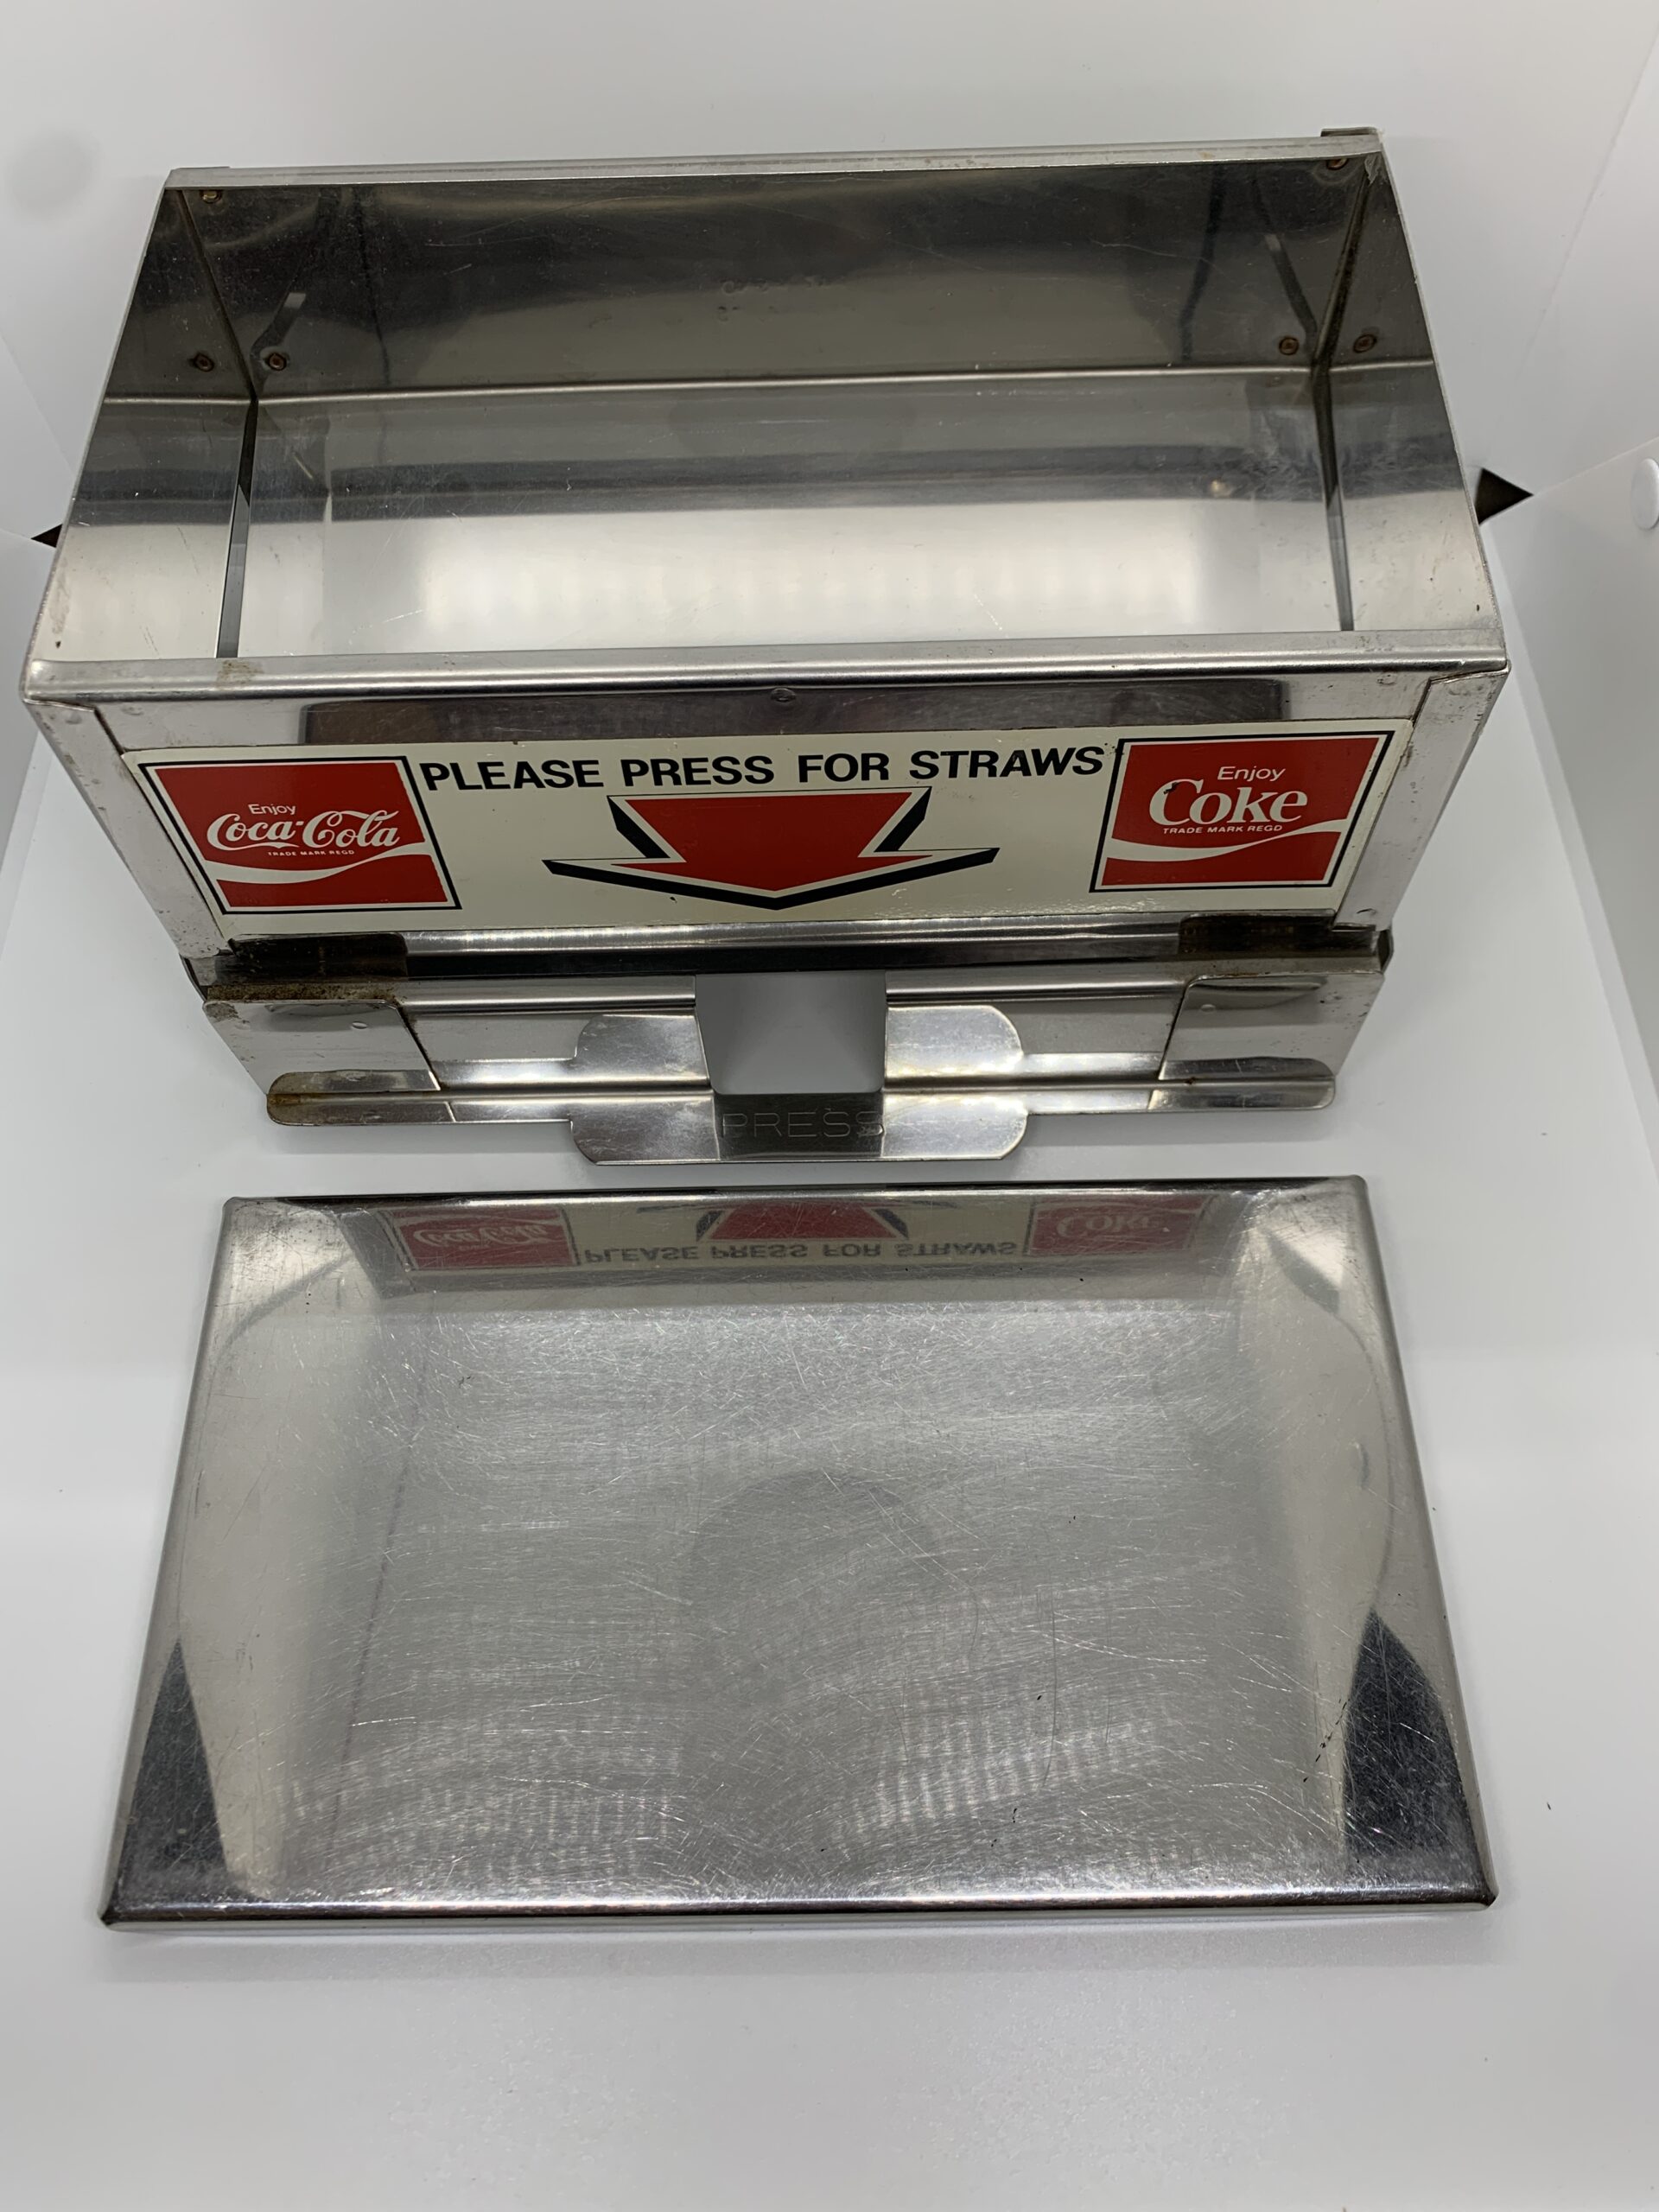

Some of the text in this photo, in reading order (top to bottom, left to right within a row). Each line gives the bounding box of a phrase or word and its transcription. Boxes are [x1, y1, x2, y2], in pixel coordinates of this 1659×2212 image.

[419, 746, 1105, 791] PLEASE PRESS FOR STRAWS
[1217, 766, 1286, 781] Enjoy
[247, 803, 296, 816] Enjoy
[1149, 779, 1308, 825] Coke
[207, 810, 400, 851] Coca-Cola
[1162, 826, 1204, 835] TRADE
[721, 1110, 885, 1138] PRESS
